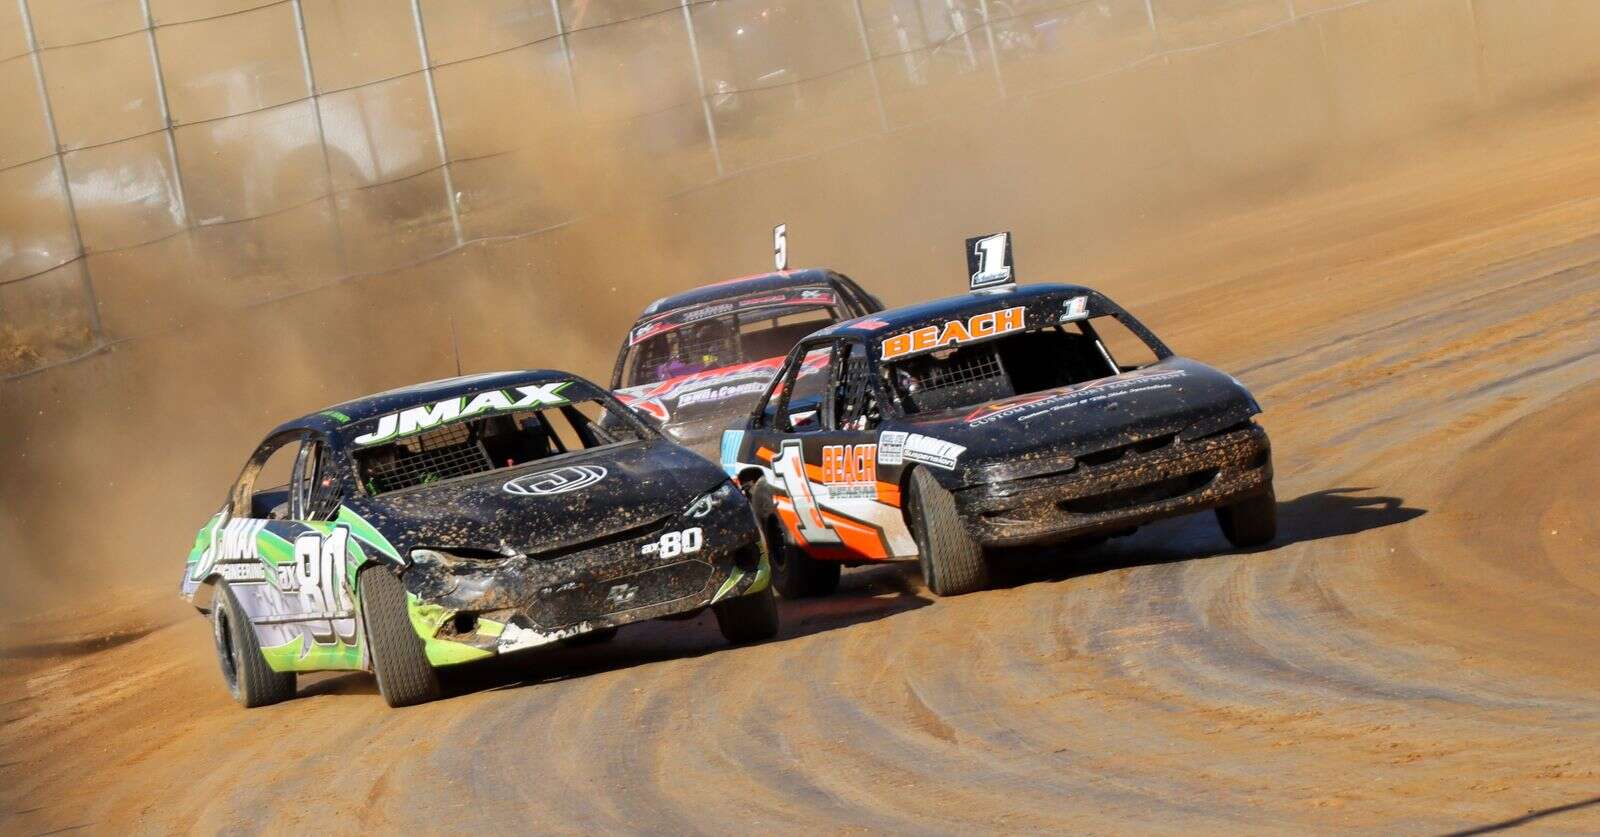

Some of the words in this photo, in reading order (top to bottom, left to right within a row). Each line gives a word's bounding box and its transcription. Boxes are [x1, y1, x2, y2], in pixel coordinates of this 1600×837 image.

[773, 223, 786, 270] 5
[971, 232, 1011, 288] 1
[880, 306, 1025, 360] BEACH
[1060, 295, 1090, 321] 1
[354, 382, 575, 445] JMAX
[970, 406, 1025, 427] CUSTOM
[822, 444, 877, 485] BEACH
[771, 438, 844, 545] 1
